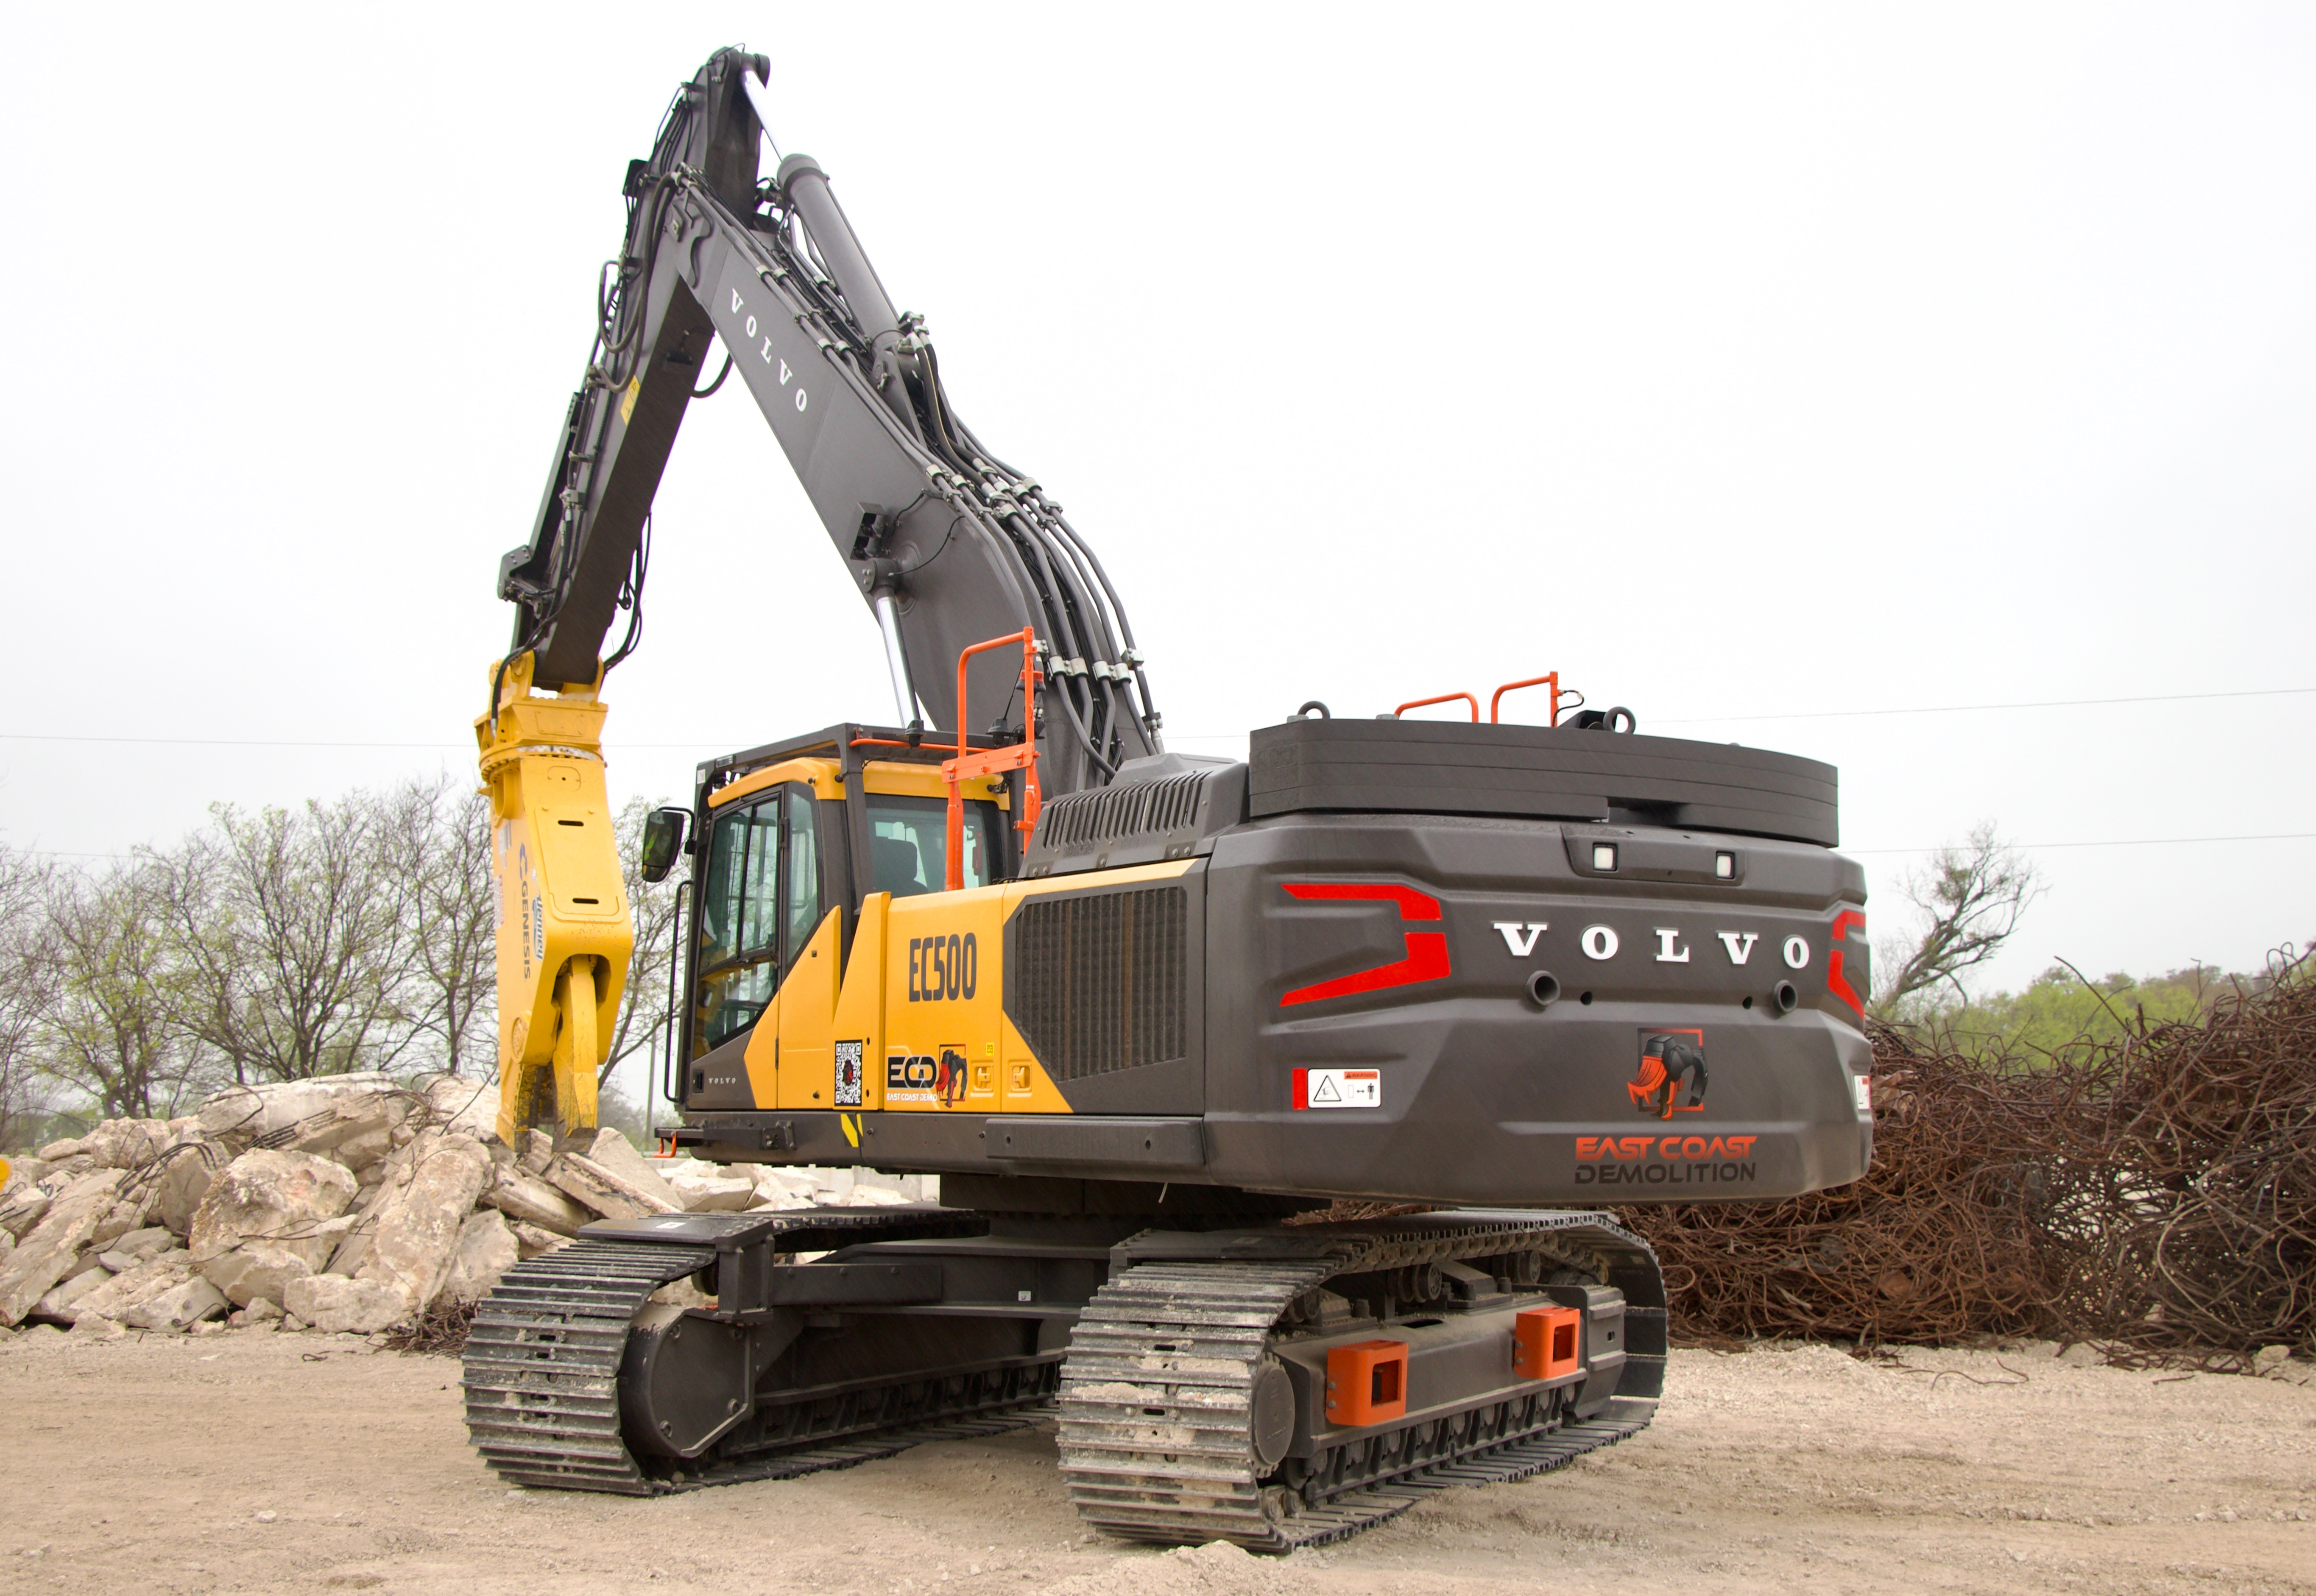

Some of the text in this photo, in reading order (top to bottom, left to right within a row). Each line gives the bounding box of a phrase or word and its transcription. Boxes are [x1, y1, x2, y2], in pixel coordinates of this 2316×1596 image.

[731, 287, 807, 412] VOLVO
[522, 880, 531, 980] GENESIS
[1493, 922, 1810, 969] VOLVO
[909, 933, 977, 1002] EC500
[887, 1093, 938, 1101] EAST COAST DEMO
[1575, 1136, 1757, 1160] EAST COAST
[1574, 1162, 1756, 1184] DEMOLITION
